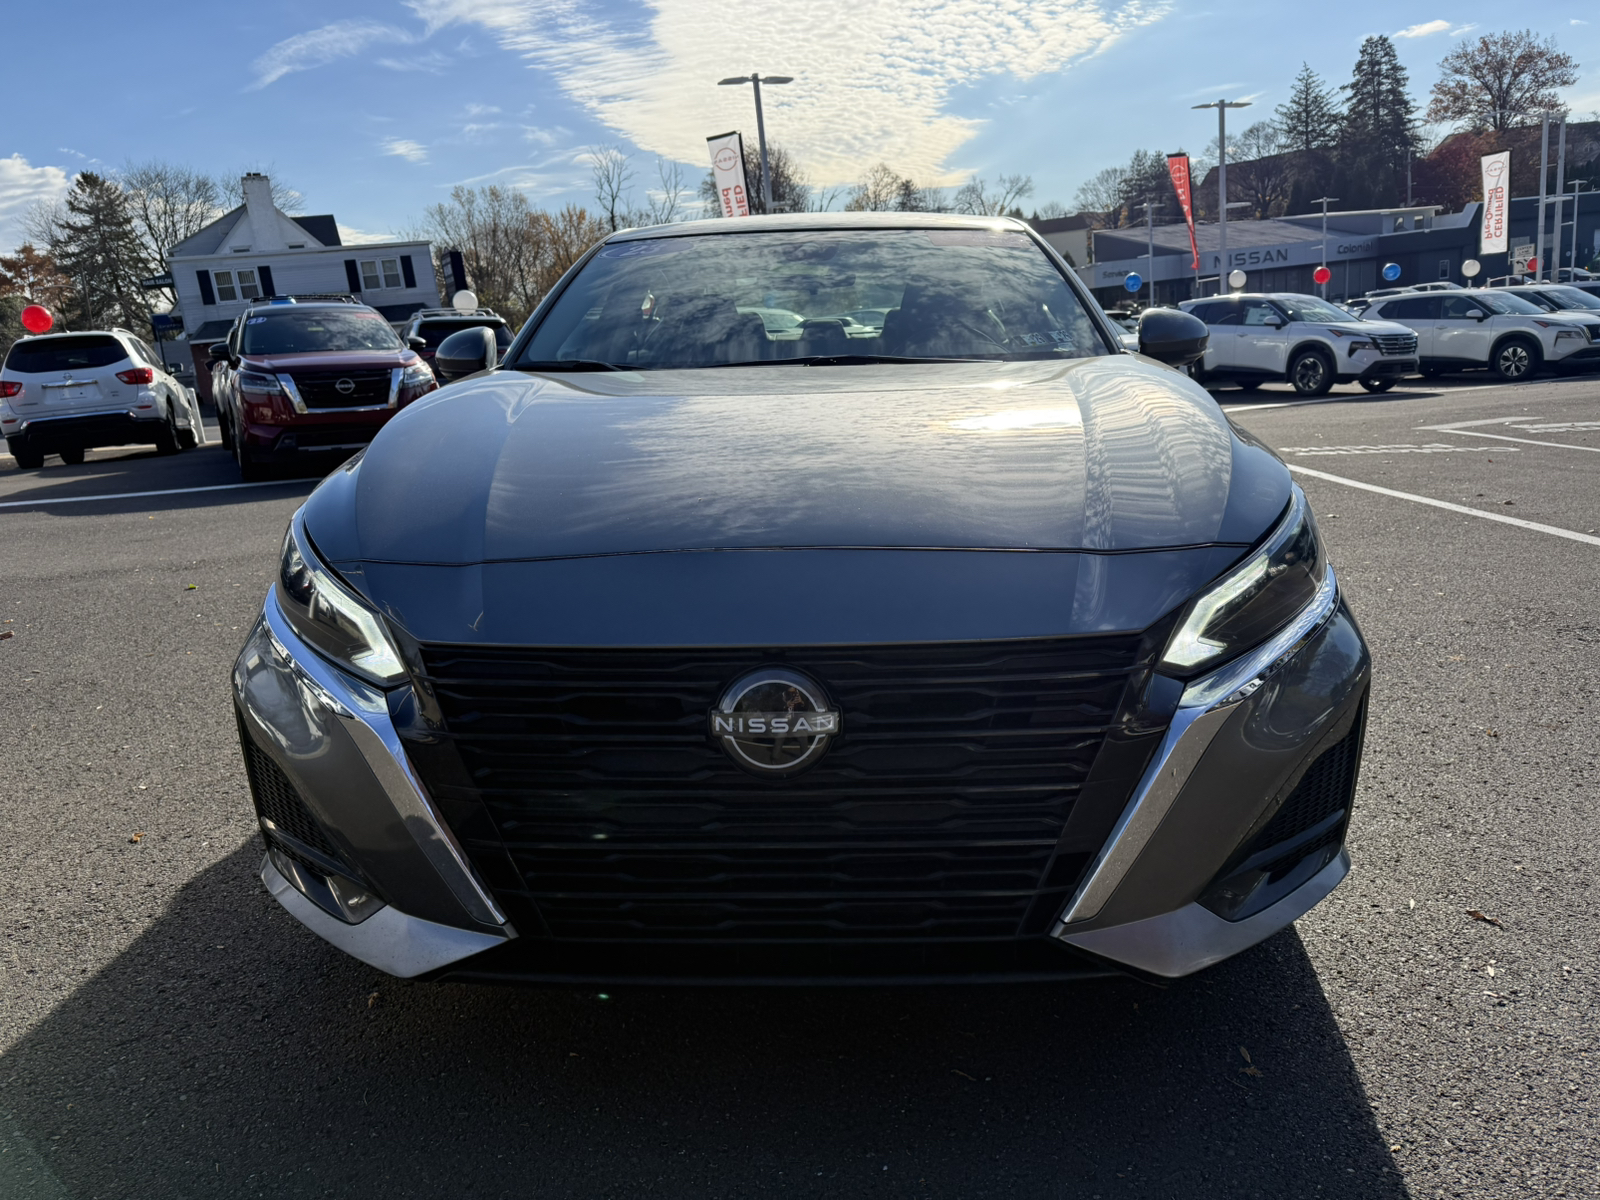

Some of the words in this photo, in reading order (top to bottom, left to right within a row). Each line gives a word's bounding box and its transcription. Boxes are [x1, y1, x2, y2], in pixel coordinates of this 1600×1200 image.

[1337, 241, 1374, 255] Colonial
[155, 277, 173, 285] SALON
[714, 716, 835, 734] NISSAN
